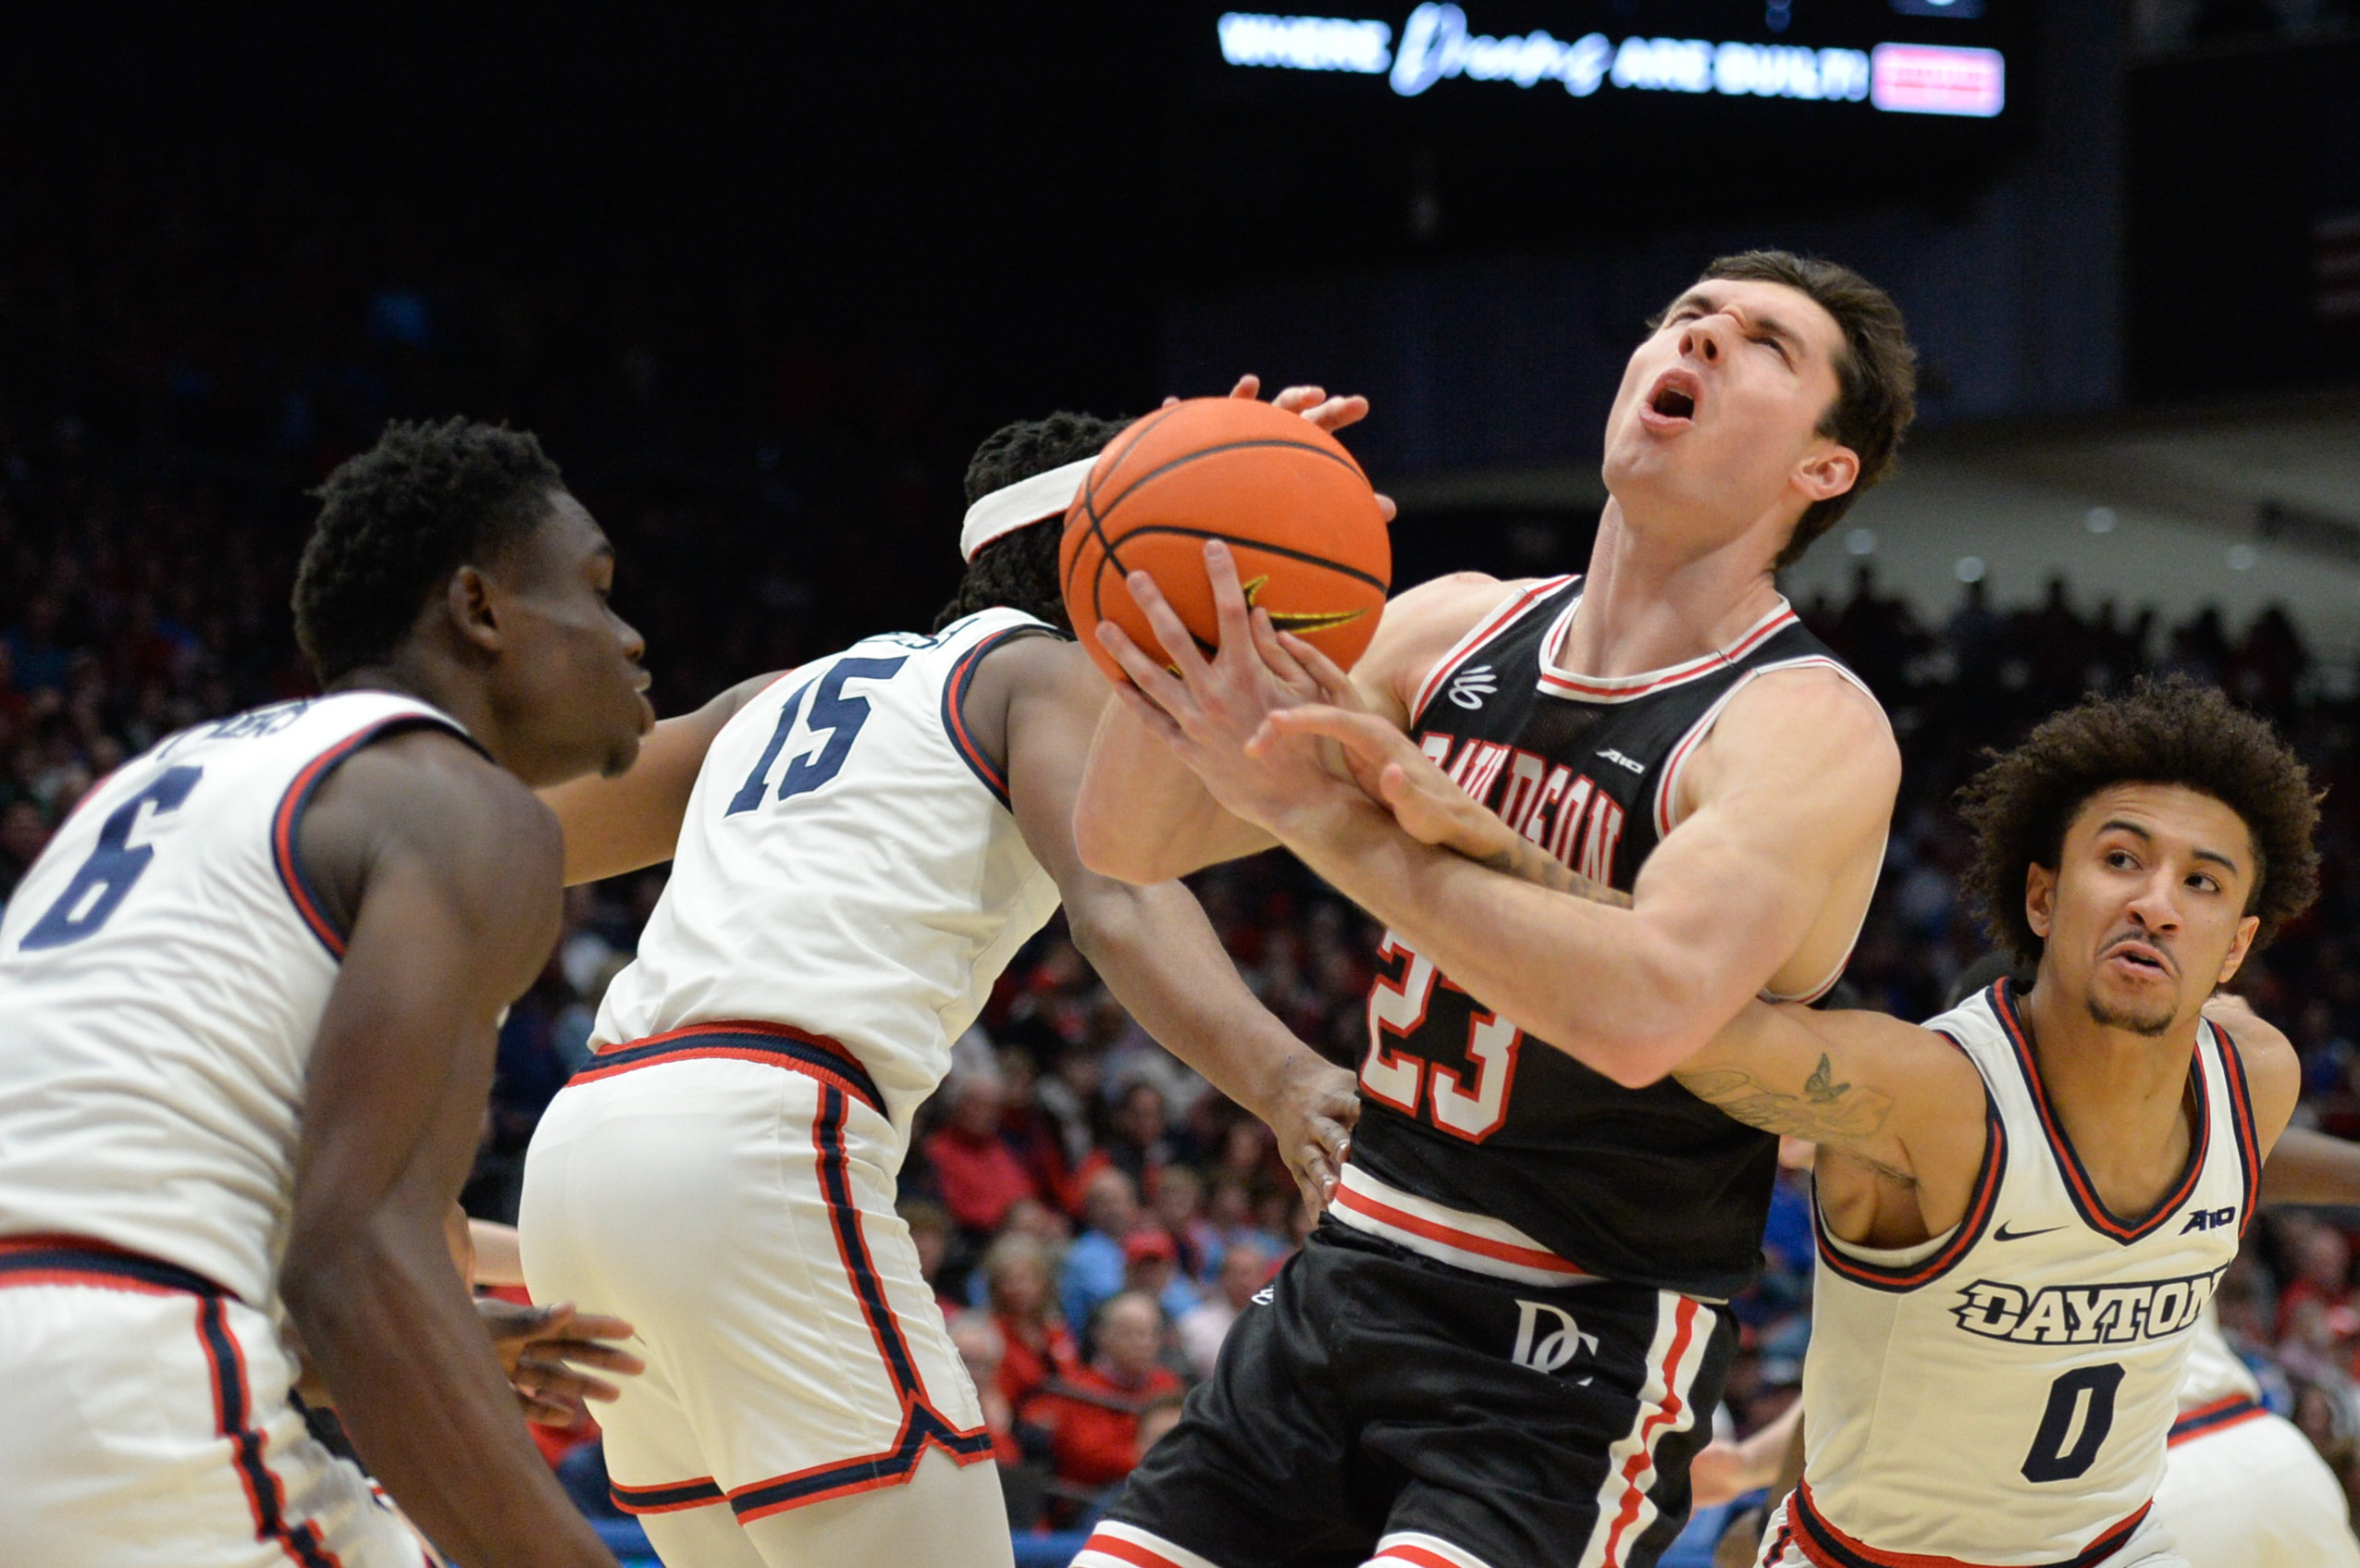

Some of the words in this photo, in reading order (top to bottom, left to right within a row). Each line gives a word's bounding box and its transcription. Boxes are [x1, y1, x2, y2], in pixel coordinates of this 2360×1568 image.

[1611, 36, 1714, 93] ARE
[723, 655, 909, 818] 15
[19, 765, 204, 952] 6
[1359, 928, 1524, 1144] 23
[2020, 1362, 2126, 1484] 0
